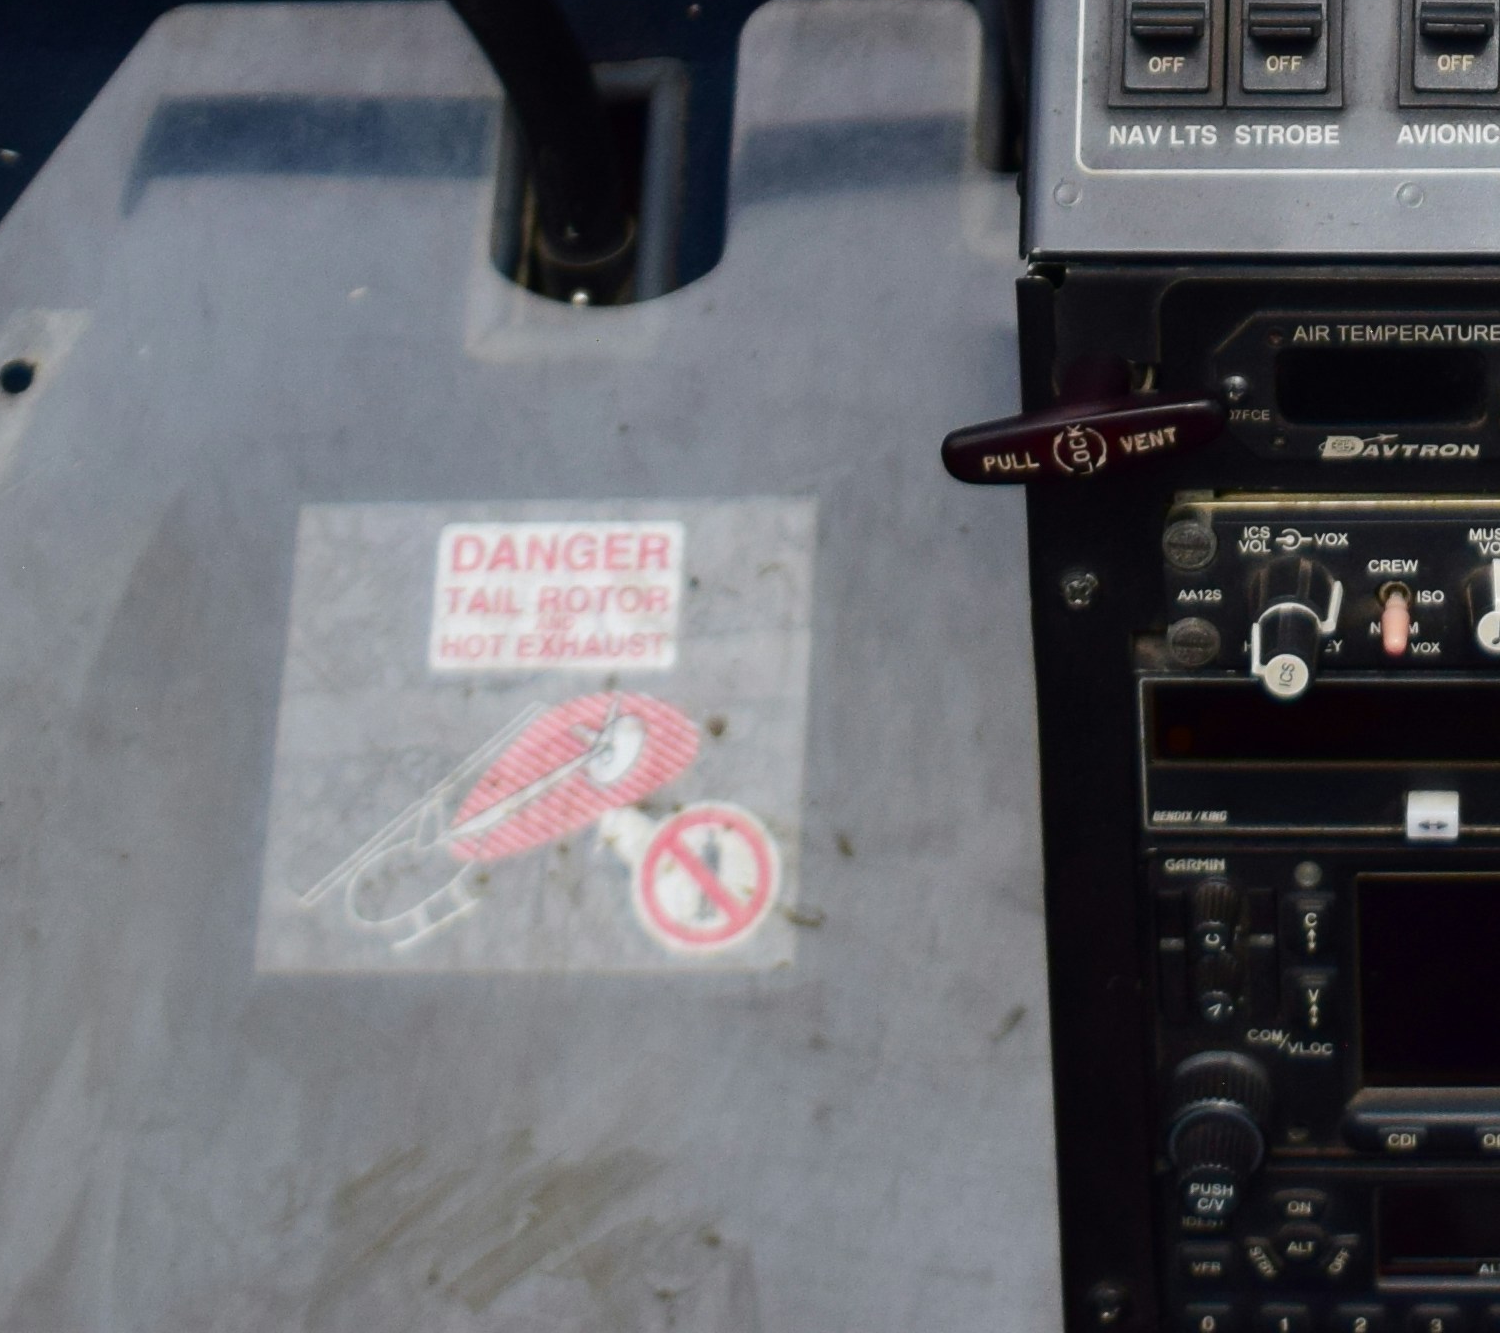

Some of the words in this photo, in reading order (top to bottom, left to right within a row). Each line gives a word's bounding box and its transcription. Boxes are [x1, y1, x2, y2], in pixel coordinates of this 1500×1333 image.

[1148, 56, 1185, 74] OFF
[1266, 55, 1303, 72] OFF
[1437, 54, 1475, 72] OFF
[1109, 125, 1163, 145] NAV
[1170, 125, 1218, 145] LTS
[1234, 124, 1340, 145] STROBE
[1293, 324, 1331, 343] AIR
[982, 452, 1040, 473] PULL
[1070, 424, 1094, 474] LOCK
[1118, 427, 1178, 454] VENT
[1243, 525, 1271, 540] ICS
[1314, 532, 1349, 547] VOX
[452, 532, 670, 572] DANGER
[1238, 539, 1272, 554] VOL
[1368, 559, 1419, 574] CREW
[444, 586, 523, 615] TAIL
[537, 585, 669, 614] ROTOR
[1177, 588, 1223, 602] AA12S
[1416, 589, 1445, 604] ISO
[439, 634, 506, 658] HOT
[515, 632, 668, 658] EXHAUST
[1410, 641, 1442, 655] VOX
[1164, 858, 1226, 872] GARMIN
[1387, 1134, 1416, 1148] CDI
[1189, 1183, 1234, 1198] PUSH
[1197, 1197, 1225, 1212] C/V
[1287, 1200, 1312, 1214] ON
[1286, 1240, 1315, 1254] ALT
